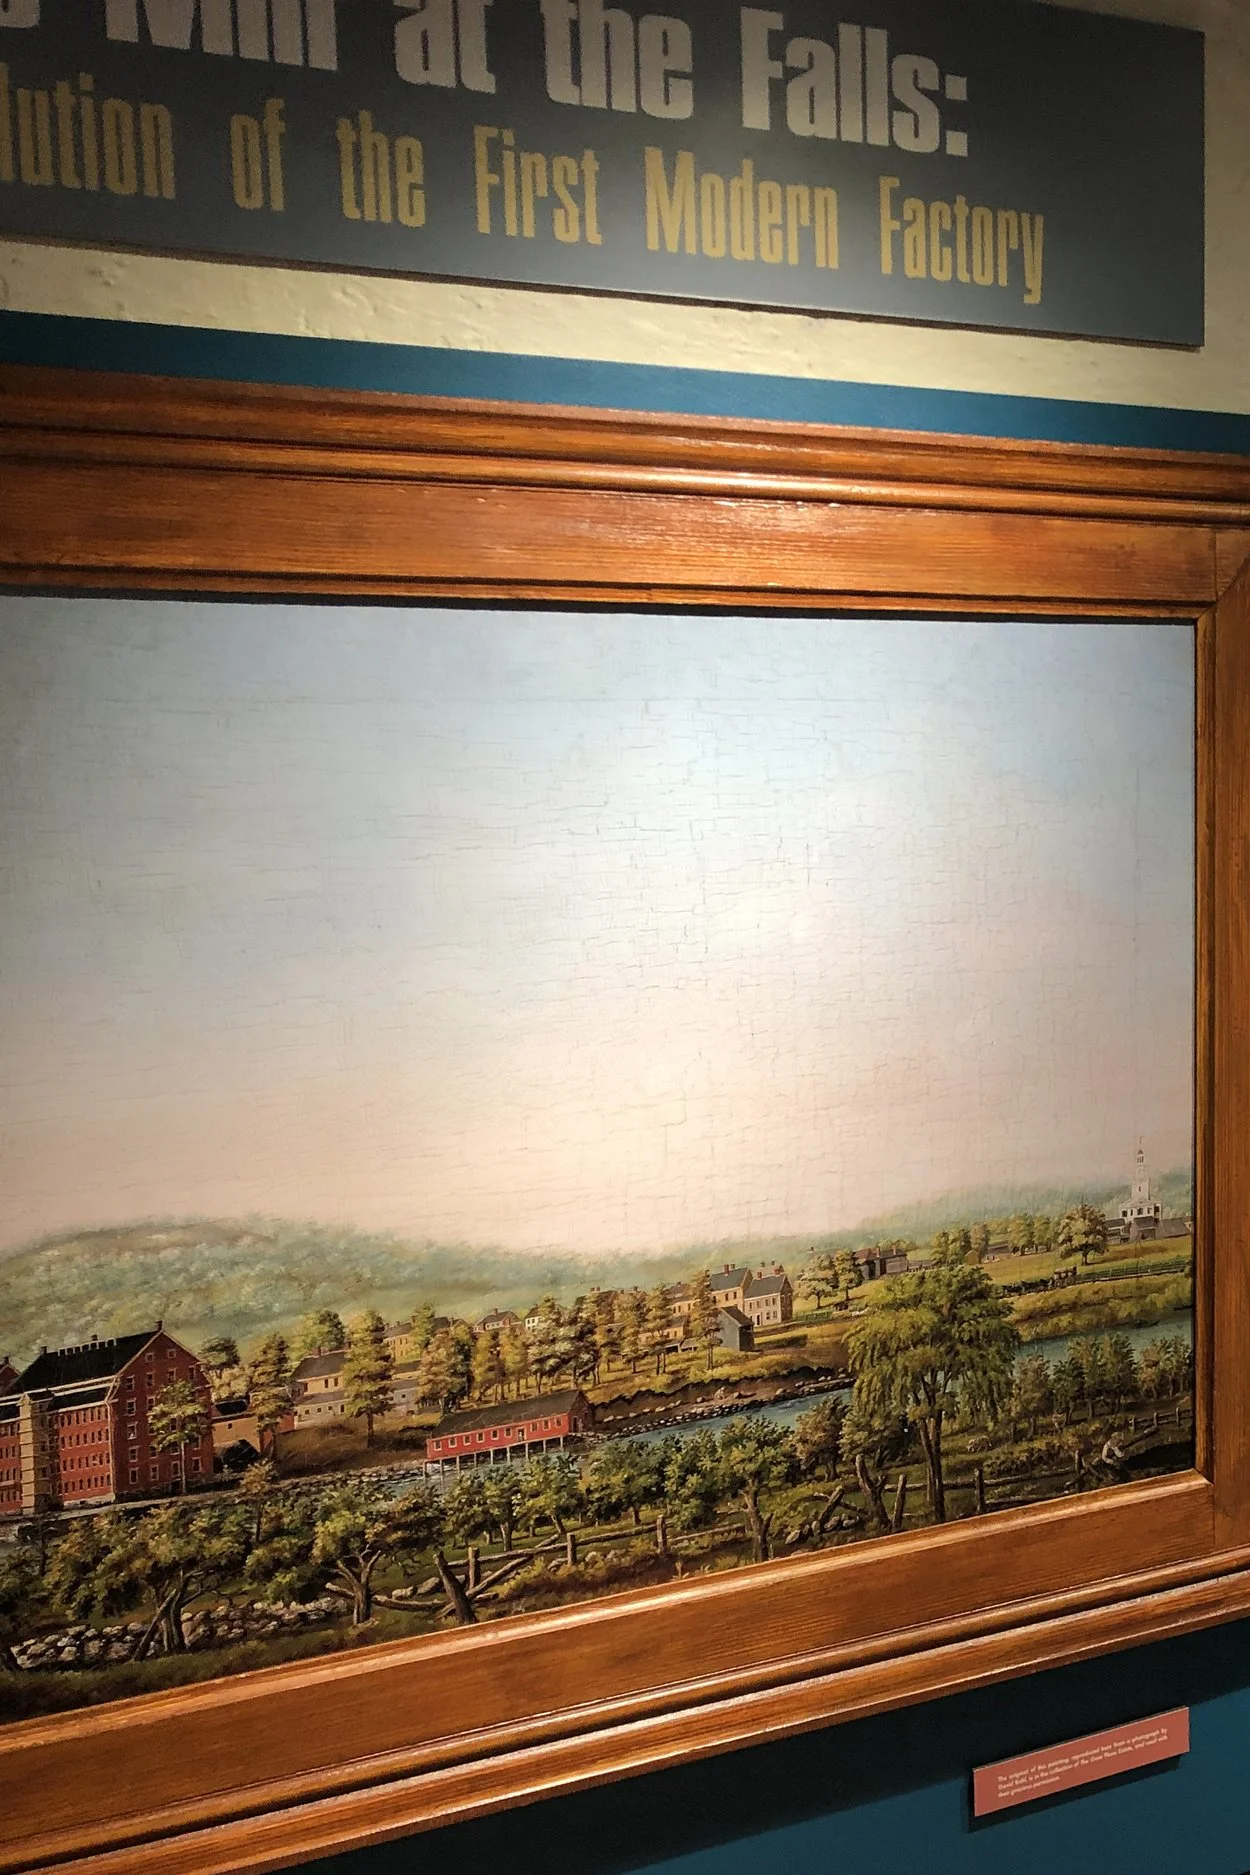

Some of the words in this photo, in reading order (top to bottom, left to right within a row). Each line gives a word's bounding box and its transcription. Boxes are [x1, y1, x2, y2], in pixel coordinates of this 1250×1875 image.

[393, 0, 496, 94] at
[540, 0, 694, 119] the
[741, 6, 968, 157] Falls:
[230, 98, 285, 212] of
[336, 109, 426, 228] the
[473, 124, 602, 245] First
[644, 146, 839, 269] Modern
[878, 176, 1044, 304] Factory
